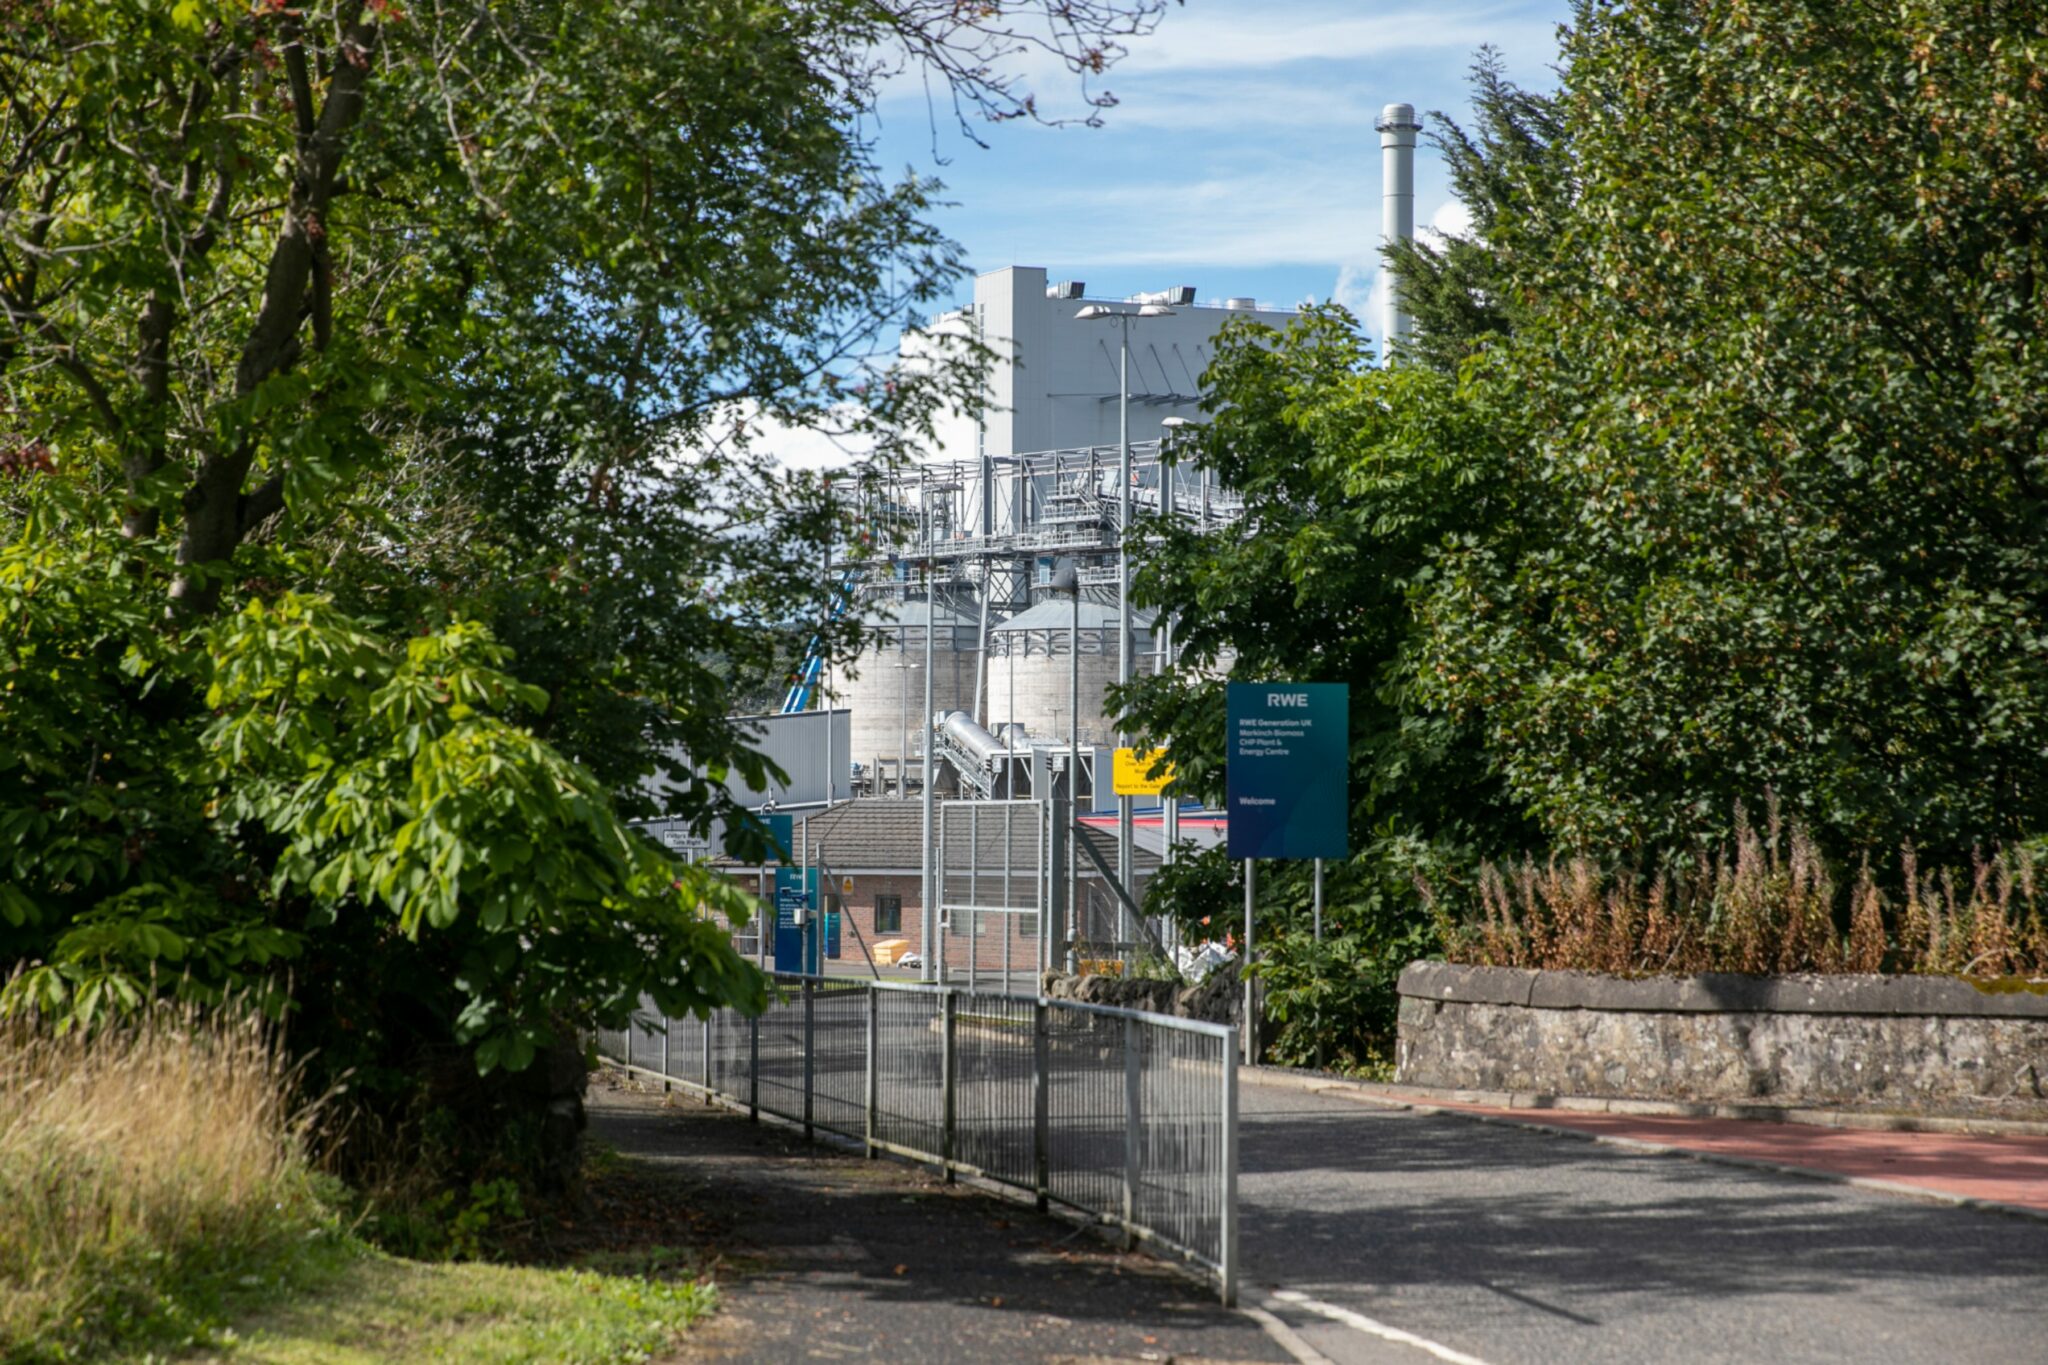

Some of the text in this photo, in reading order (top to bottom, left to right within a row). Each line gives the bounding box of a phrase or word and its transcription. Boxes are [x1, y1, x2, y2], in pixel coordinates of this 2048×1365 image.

[1267, 693, 1308, 706] RWE
[1239, 729, 1304, 737] Markinch Biomass
[1239, 748, 1290, 757] Energy Centre
[1239, 797, 1276, 805] Welcome
